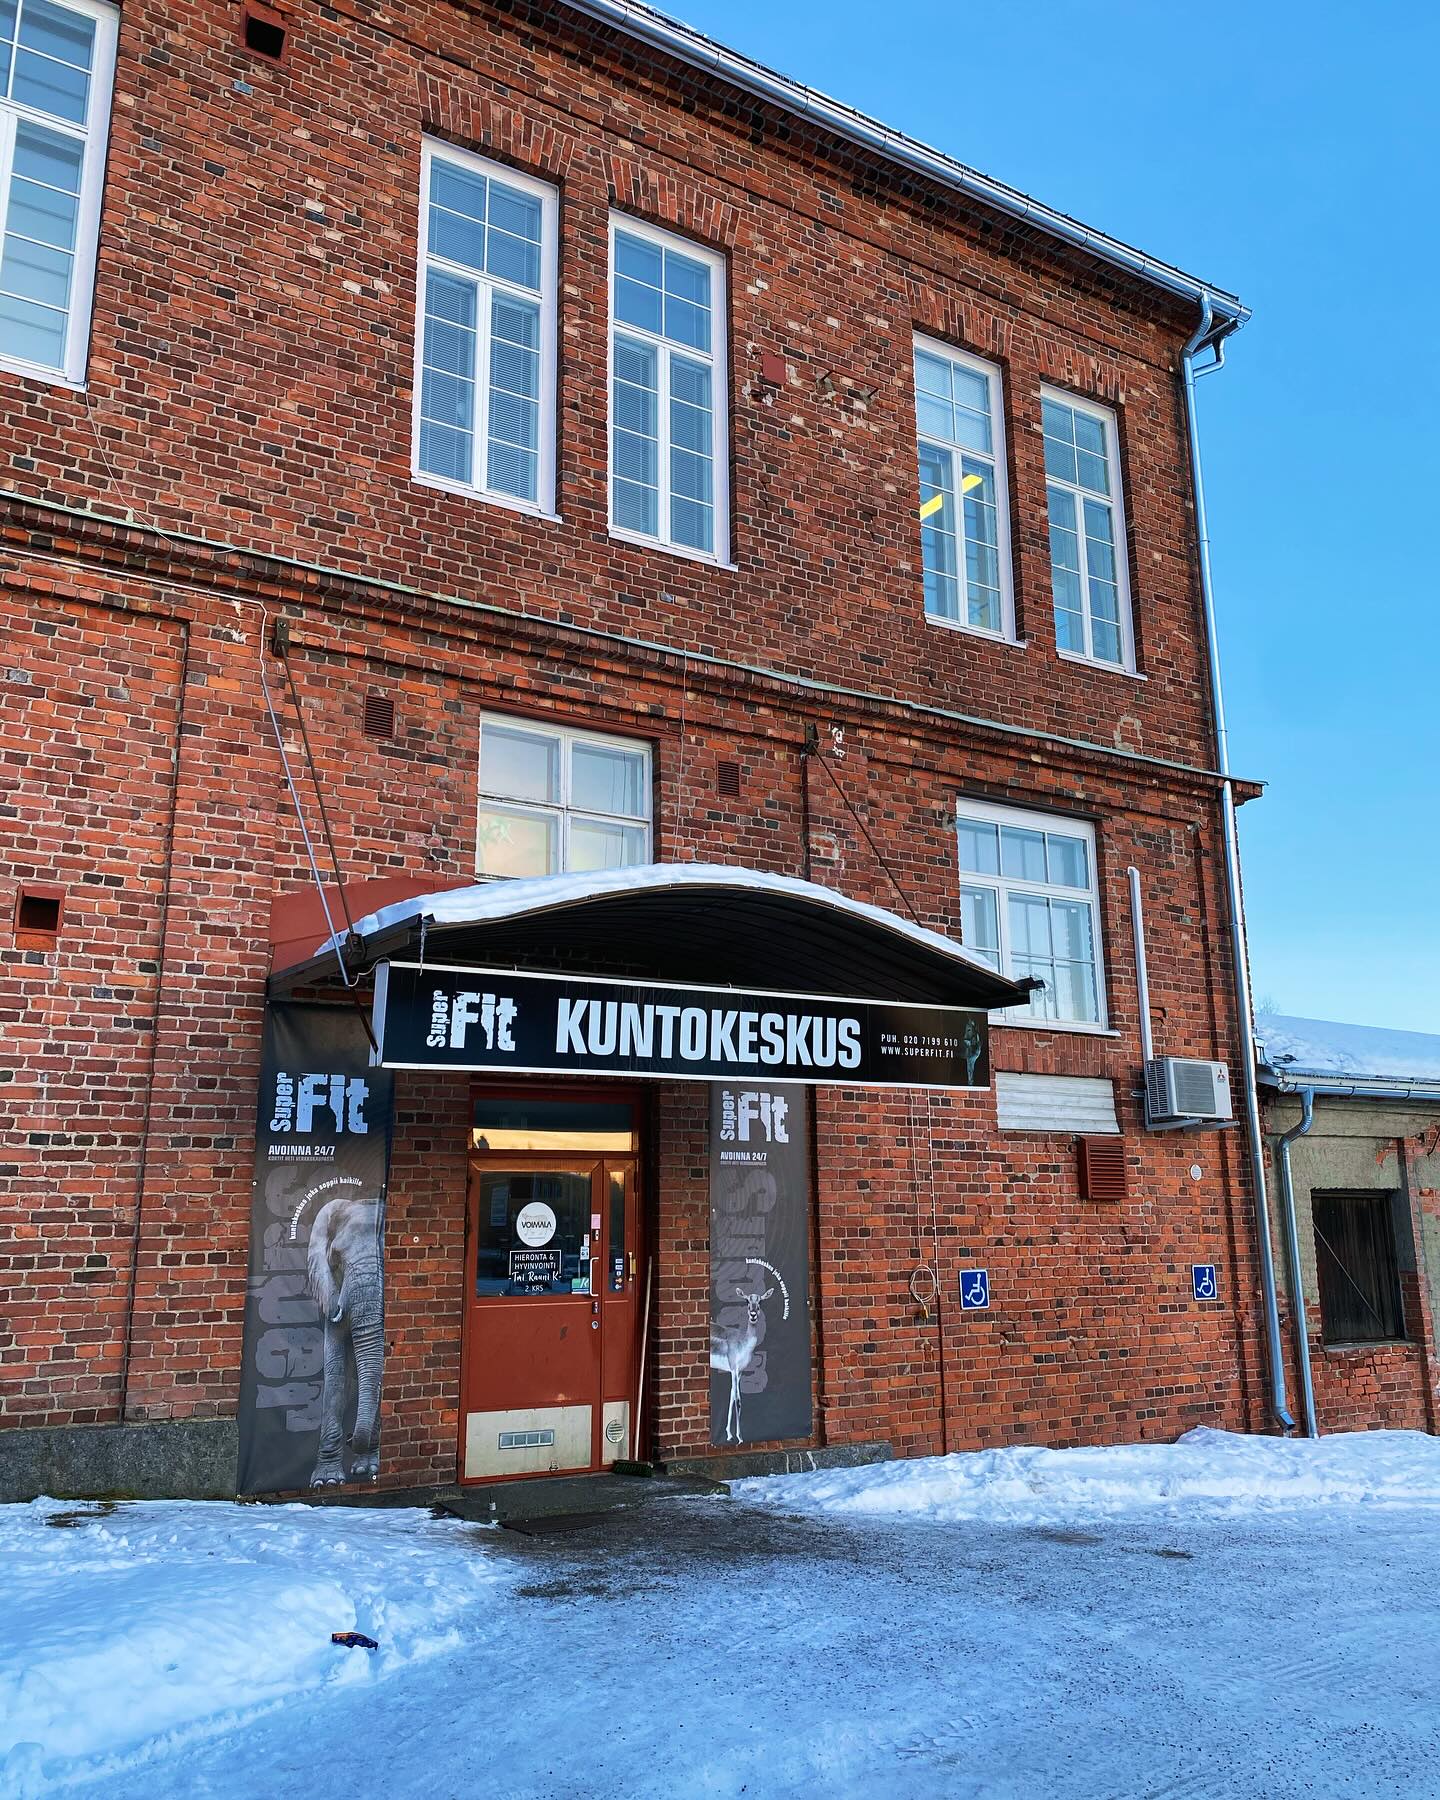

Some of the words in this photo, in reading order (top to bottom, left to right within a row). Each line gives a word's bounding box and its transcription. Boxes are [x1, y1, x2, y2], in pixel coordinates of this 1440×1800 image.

[426, 989, 450, 1048] Super
[450, 991, 518, 1051] Fit
[555, 998, 861, 1069] KUNTOKESKUS
[881, 1033, 900, 1043] PUH.
[903, 1035, 918, 1045] 020
[921, 1036, 941, 1047] 7199
[944, 1038, 958, 1047] 610
[880, 1045, 954, 1058] WWW.SUPERFIT.FI
[270, 1072, 296, 1132] Super
[296, 1073, 370, 1134] Fit
[720, 1090, 737, 1141] Super
[738, 1091, 789, 1143] Fit
[268, 1145, 312, 1156] AVOINNA
[314, 1145, 336, 1156] 24/7
[720, 1151, 751, 1161] AVOINNA
[752, 1152, 767, 1161] 24/7
[289, 1199, 307, 1240] kuntokeskus
[304, 1187, 319, 1201] joka
[339, 1176, 363, 1187] kaikille
[514, 1253, 548, 1261] HIERONTA
[549, 1253, 555, 1261] &
[514, 1262, 556, 1270] HYVINVOINTI
[531, 1284, 544, 1292] KRS
